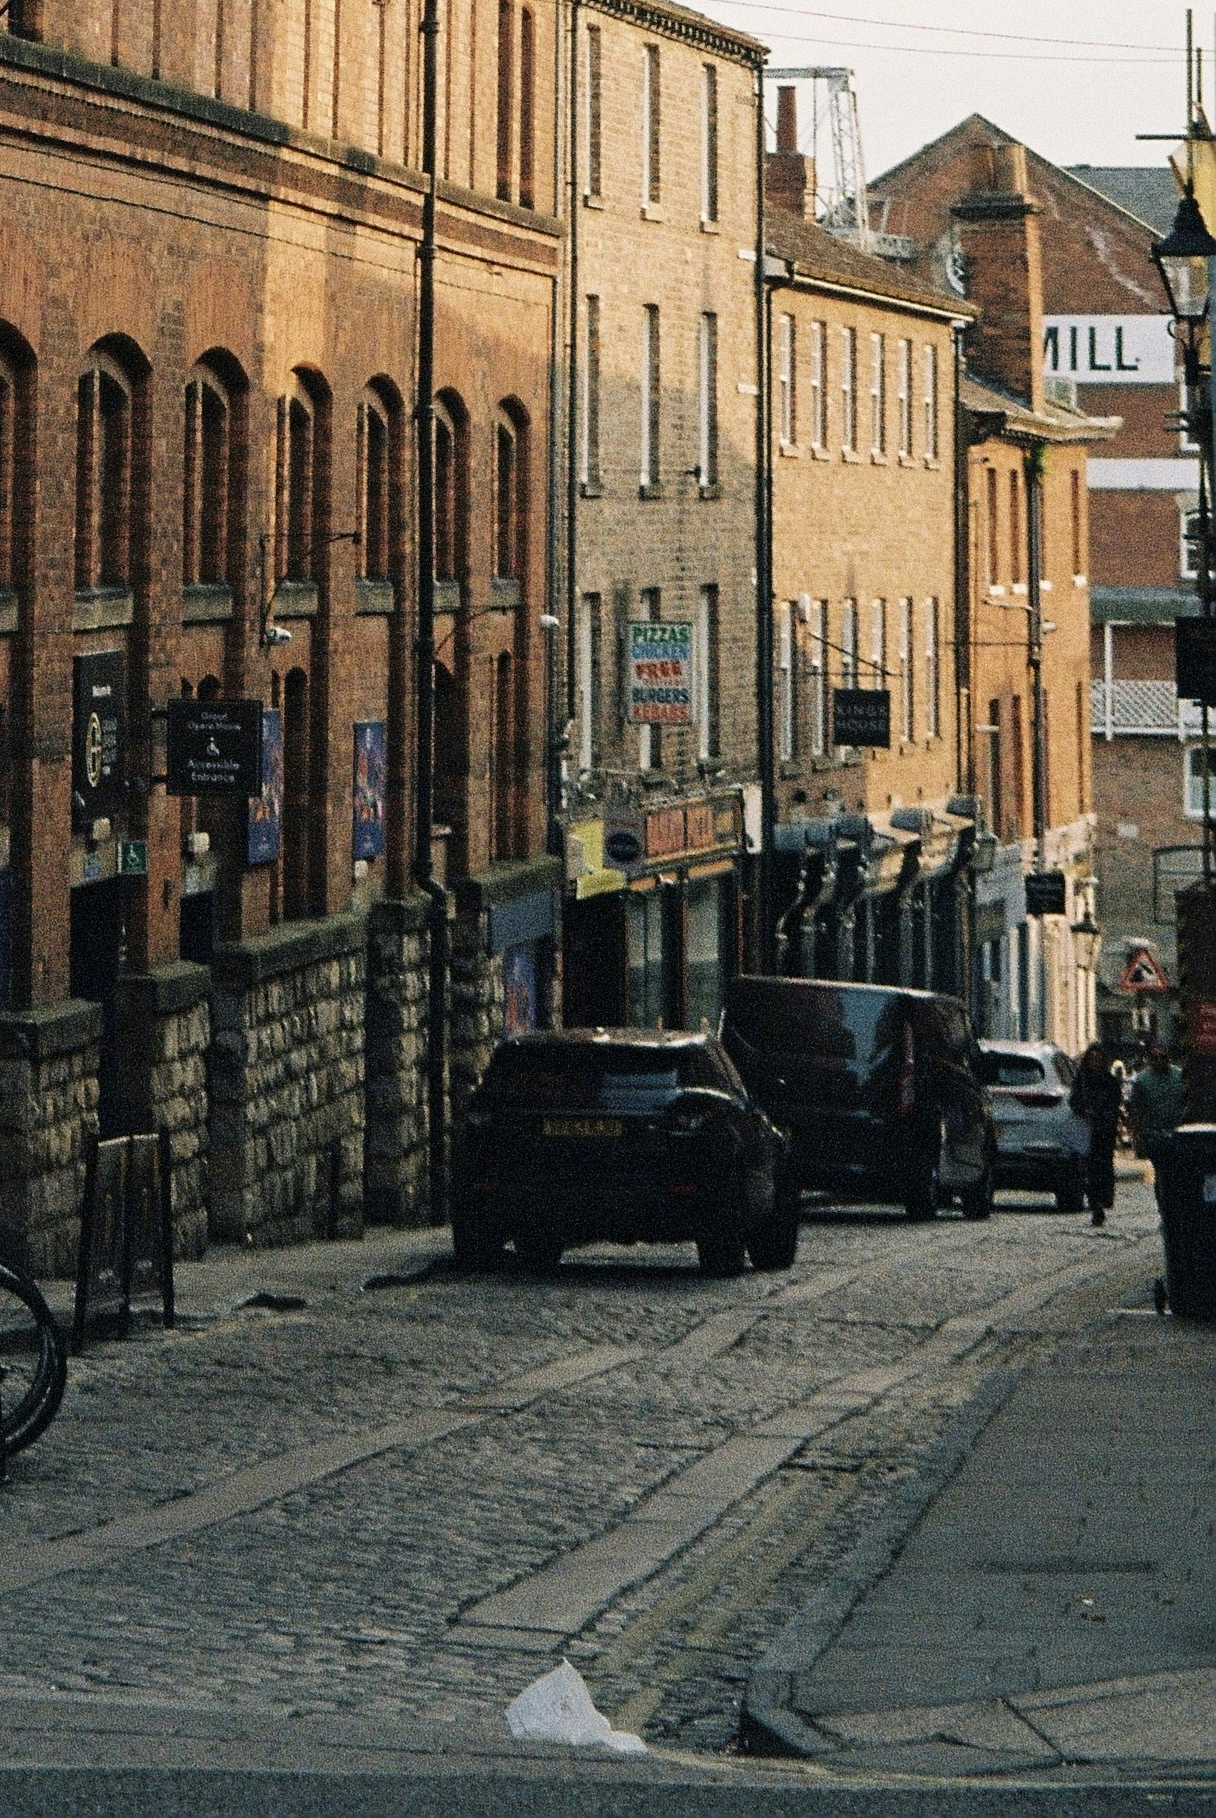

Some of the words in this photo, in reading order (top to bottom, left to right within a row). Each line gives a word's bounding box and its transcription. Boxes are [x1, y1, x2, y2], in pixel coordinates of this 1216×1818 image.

[632, 626, 689, 643] PIZZAS
[635, 660, 683, 679] FREE
[632, 688, 690, 703] BURGERS
[191, 771, 235, 782] Entrance
